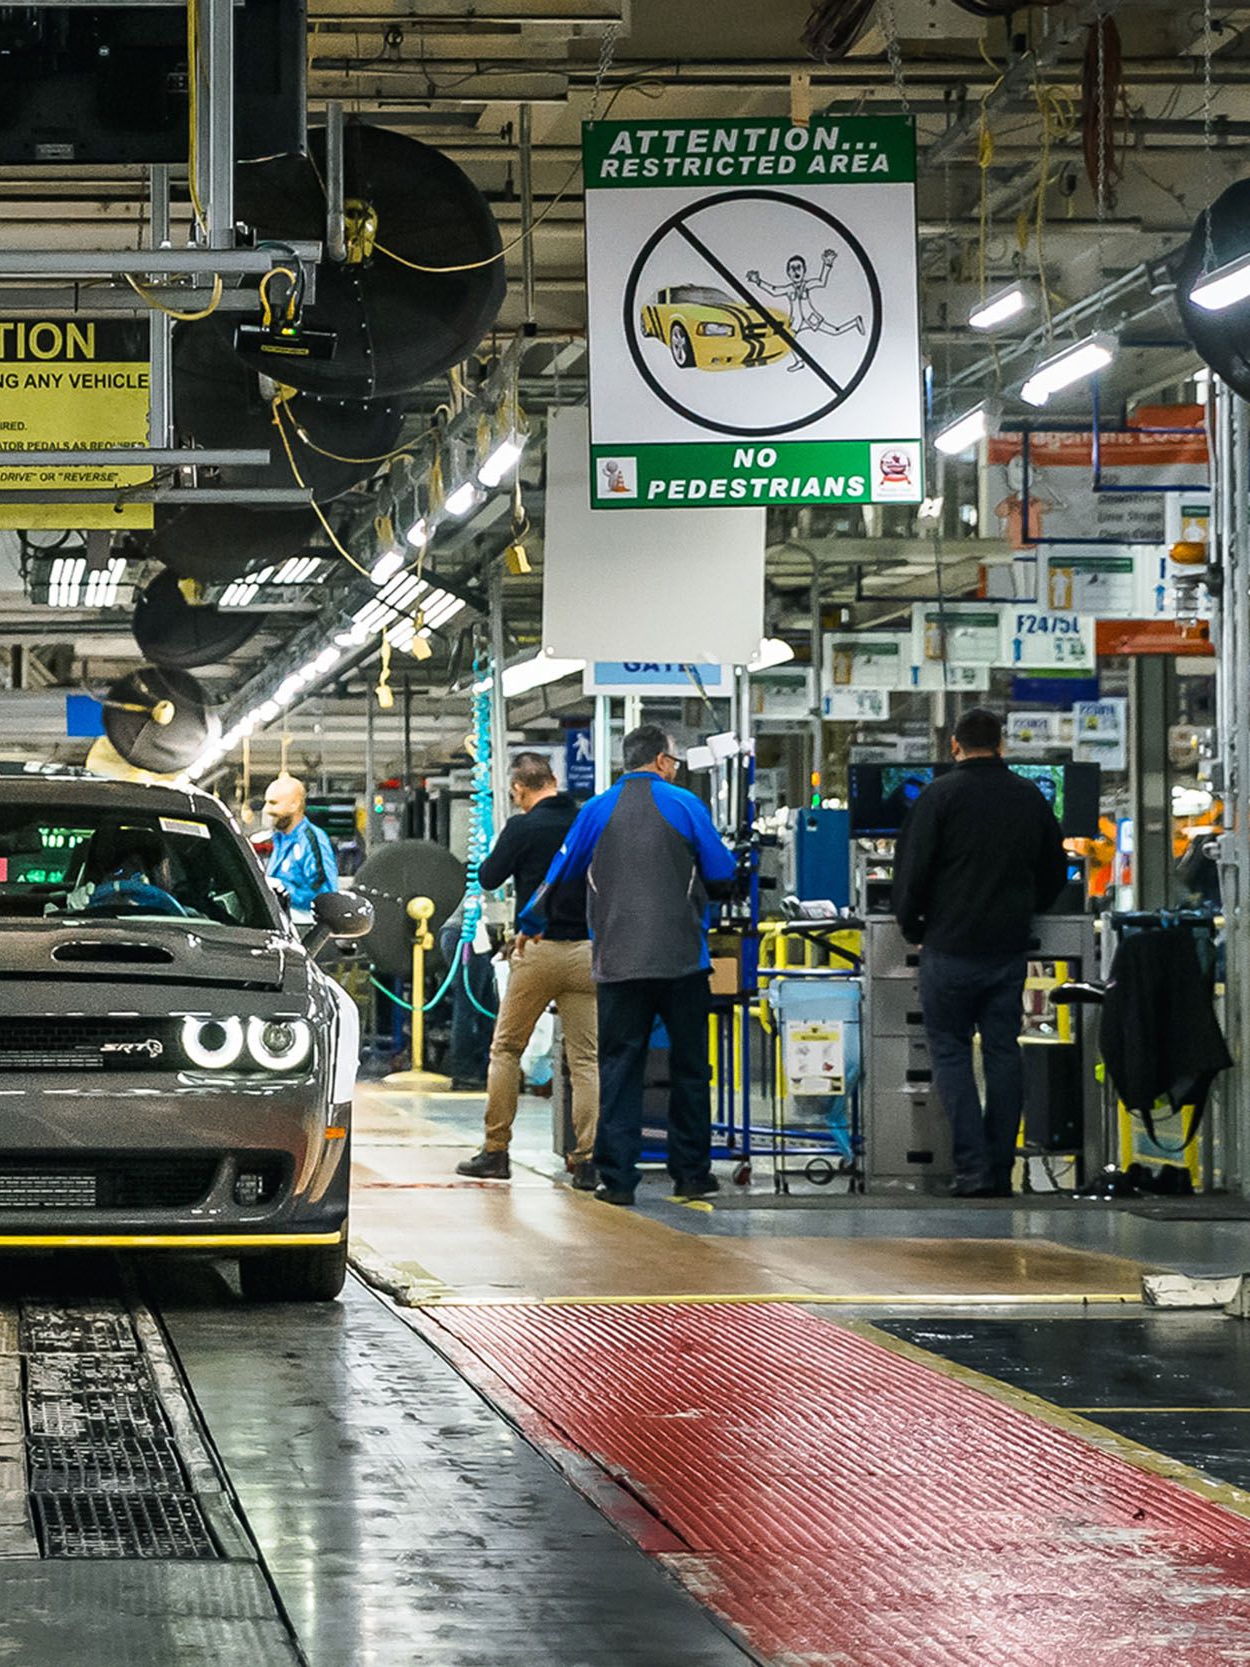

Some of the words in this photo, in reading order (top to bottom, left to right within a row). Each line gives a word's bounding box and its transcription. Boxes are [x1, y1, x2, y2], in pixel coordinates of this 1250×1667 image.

[609, 126, 878, 155] ATTENTION...
[600, 155, 797, 178] RESTRICTED
[807, 153, 890, 175] AREA
[24, 373, 63, 389] ANY
[69, 373, 149, 389] VEHICLE
[27, 441, 70, 451] PEDALS
[733, 447, 779, 469] NO
[40, 472, 56, 482] OR
[648, 476, 866, 501] PEDESTRIANS
